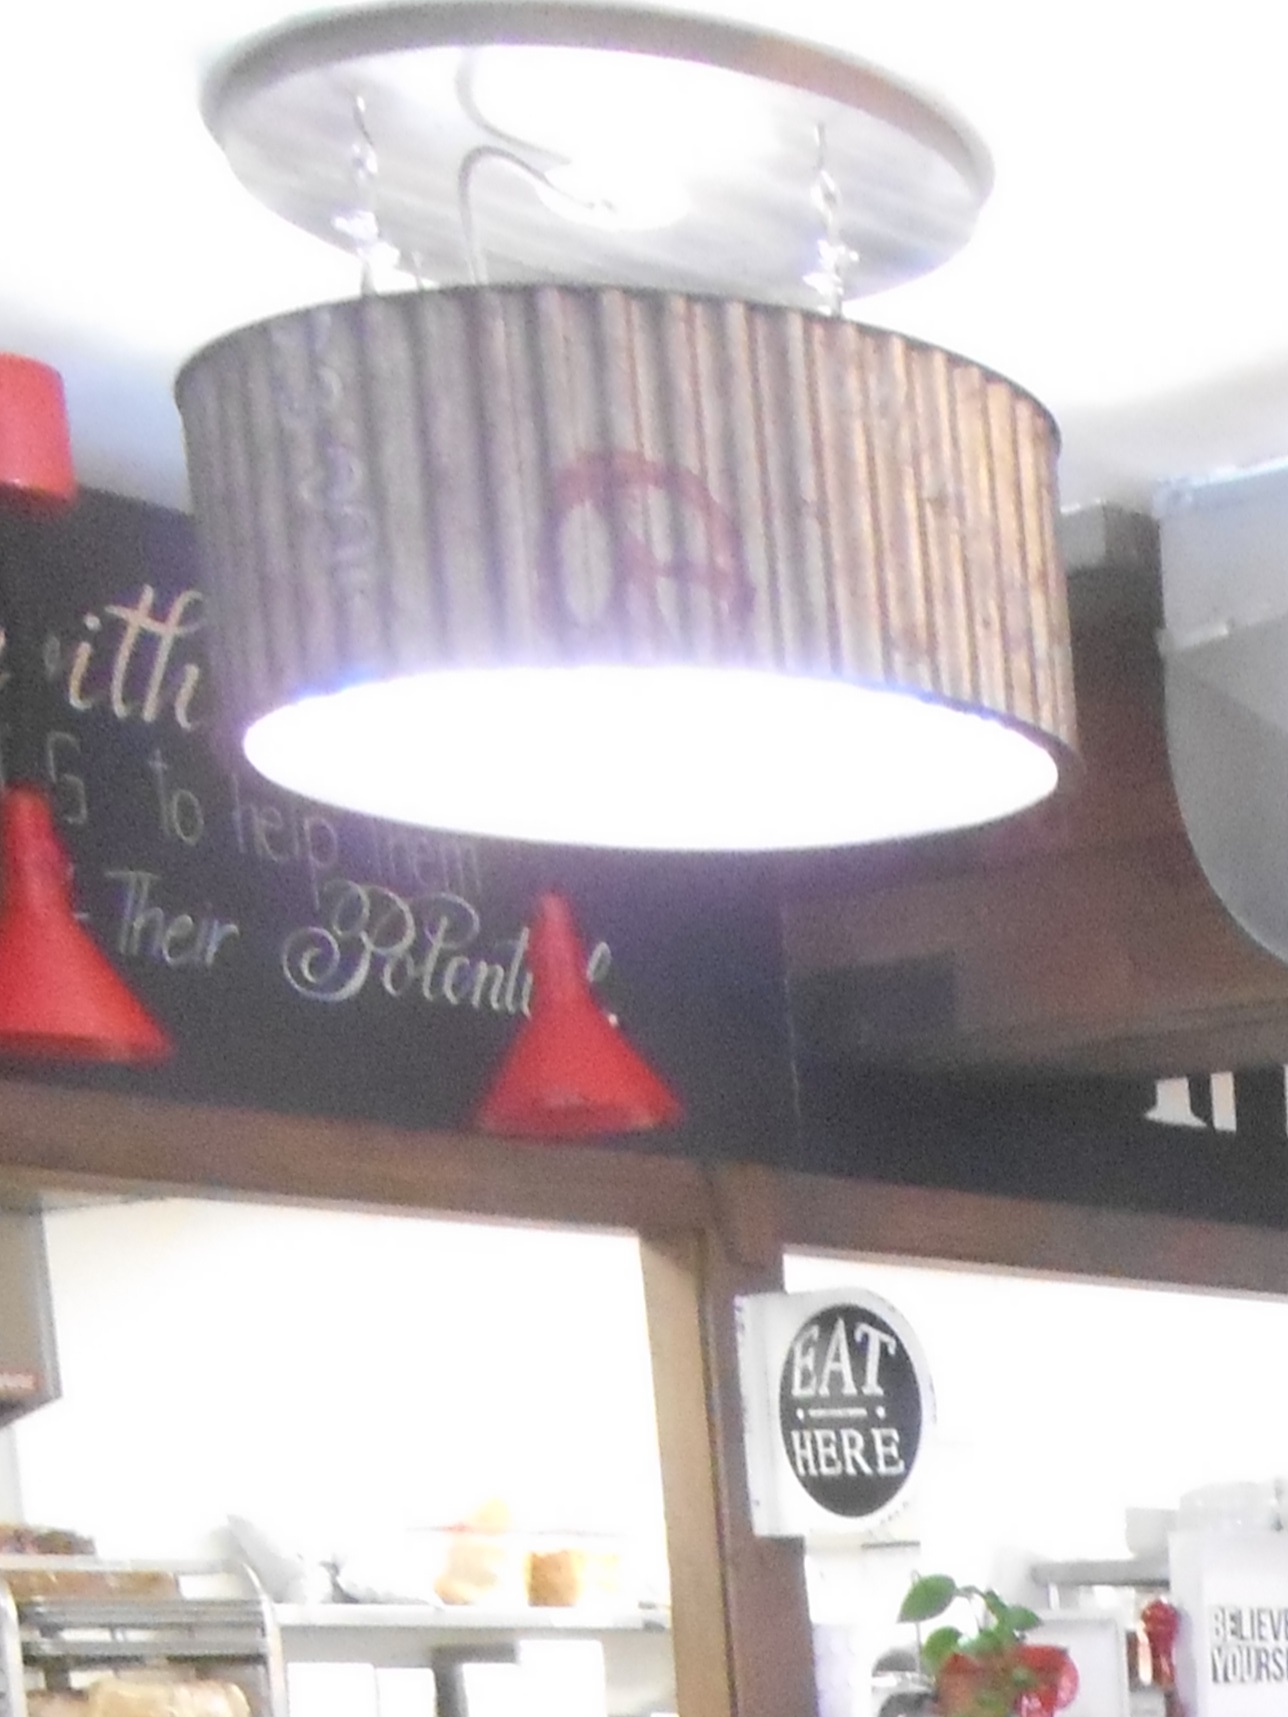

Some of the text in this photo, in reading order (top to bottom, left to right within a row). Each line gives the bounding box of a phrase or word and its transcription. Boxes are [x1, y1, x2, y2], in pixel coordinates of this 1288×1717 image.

[68, 583, 205, 733] ith
[104, 868, 240, 969] Their
[790, 1316, 897, 1397] EAT
[790, 1428, 906, 1477] HERE
